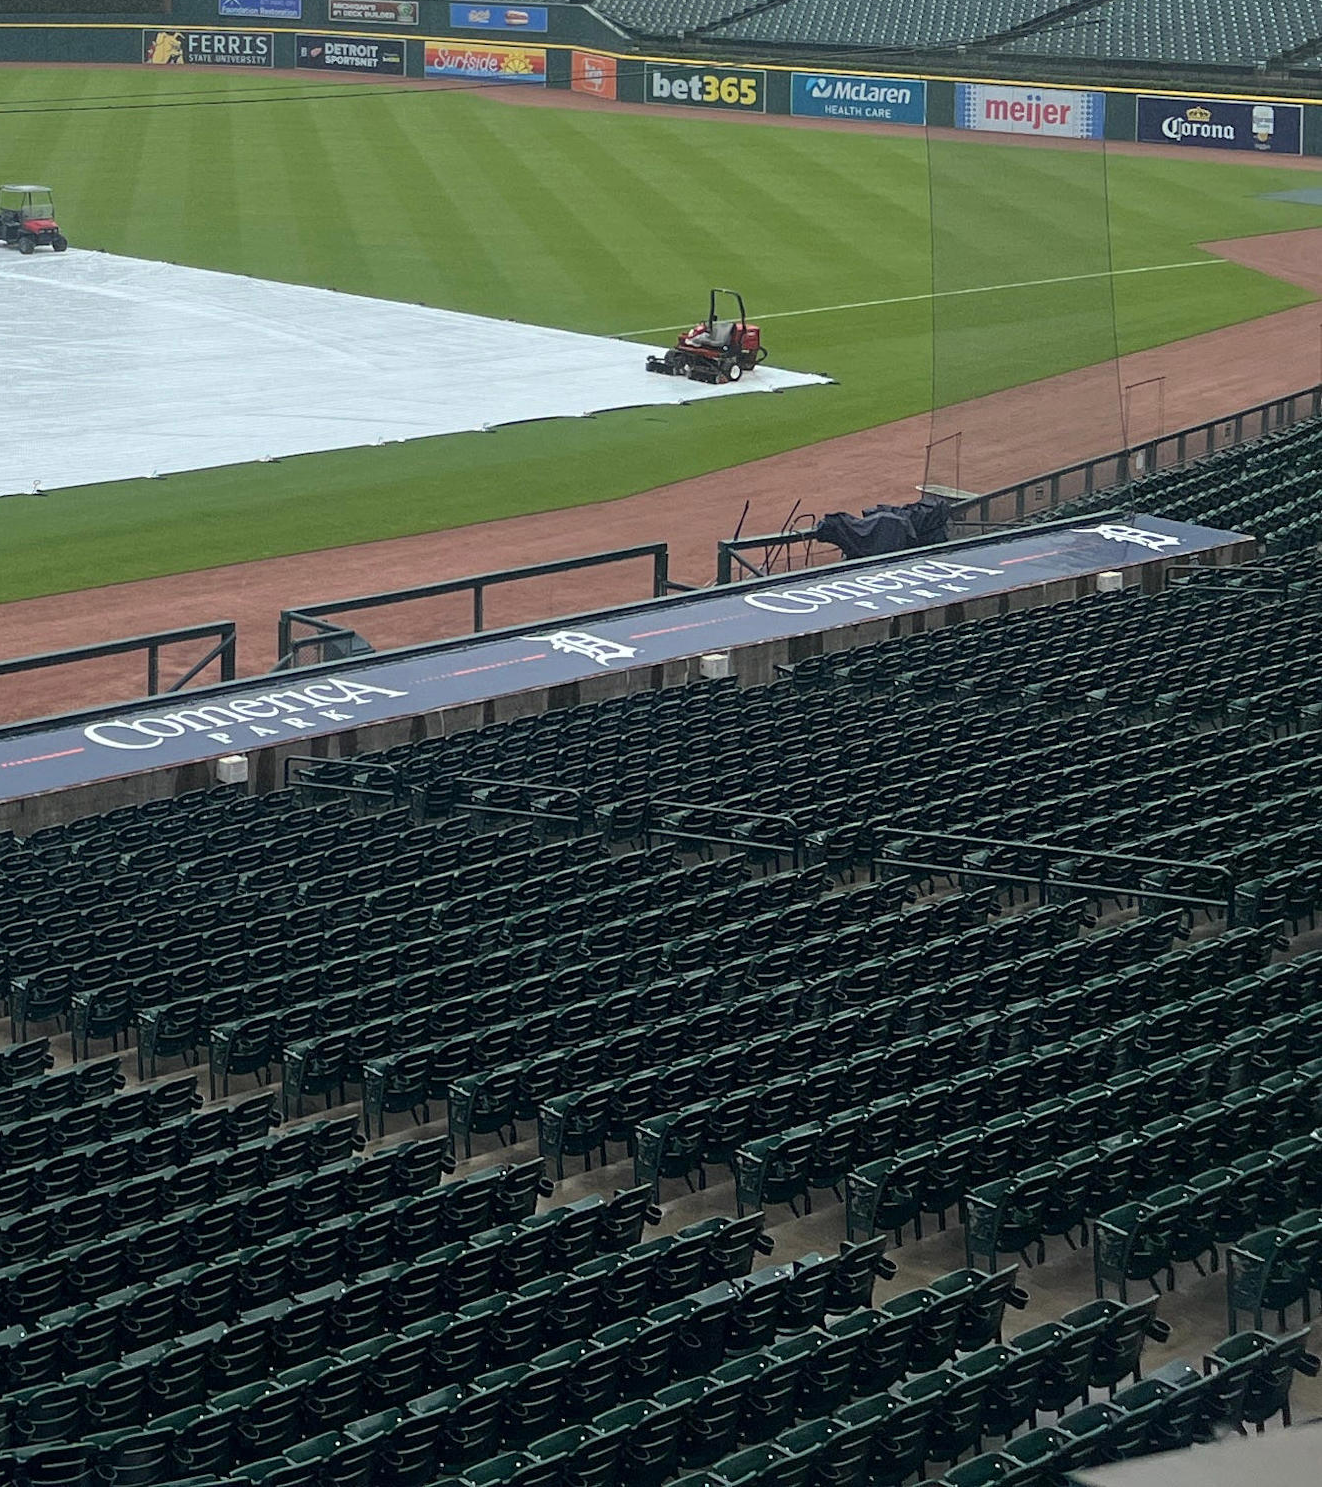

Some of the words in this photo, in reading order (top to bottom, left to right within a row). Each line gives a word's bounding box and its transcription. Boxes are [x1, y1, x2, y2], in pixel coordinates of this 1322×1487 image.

[188, 33, 268, 56] FERRIS
[324, 42, 379, 58] DETROIT
[188, 53, 212, 63] STATE
[215, 54, 267, 65] UNIVERSITY
[324, 56, 379, 68] SPORTSNET
[433, 47, 498, 73] Surfside
[652, 72, 757, 106] bet365
[833, 82, 911, 104] McLaren
[824, 104, 862, 116] HEALTH
[865, 107, 892, 119] CARE
[985, 94, 1071, 129] meijer
[1161, 116, 1235, 142] Corona
[854, 582, 971, 611] PARK
[207, 709, 355, 745] PARK
